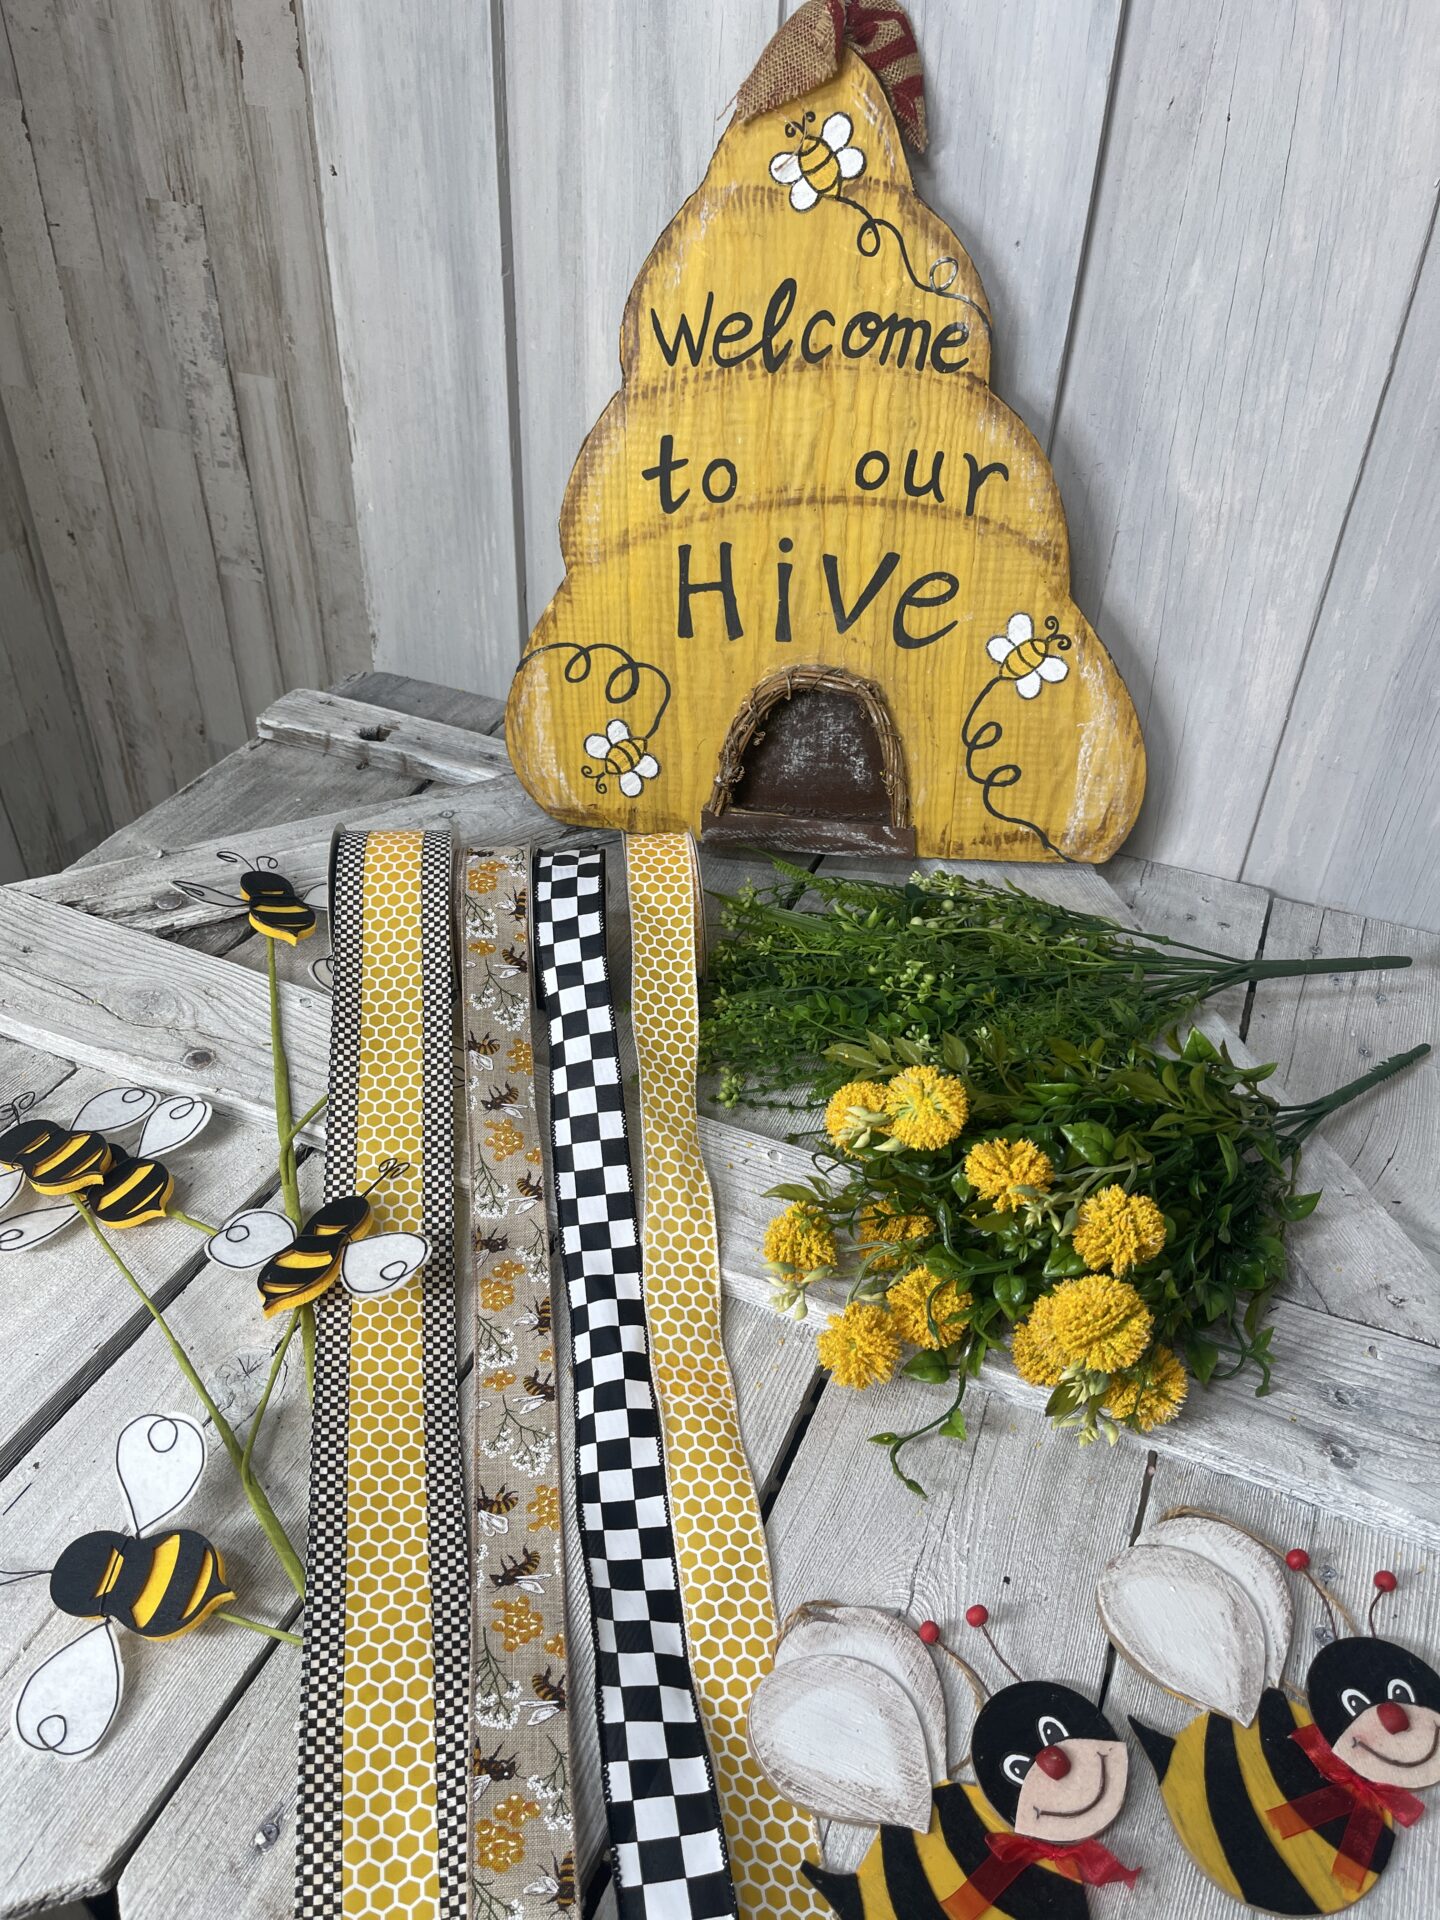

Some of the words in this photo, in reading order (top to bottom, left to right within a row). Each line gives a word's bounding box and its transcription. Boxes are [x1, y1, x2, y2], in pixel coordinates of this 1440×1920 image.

[651, 278, 970, 374] Welcome
[641, 434, 738, 514] to
[855, 449, 1010, 516] our
